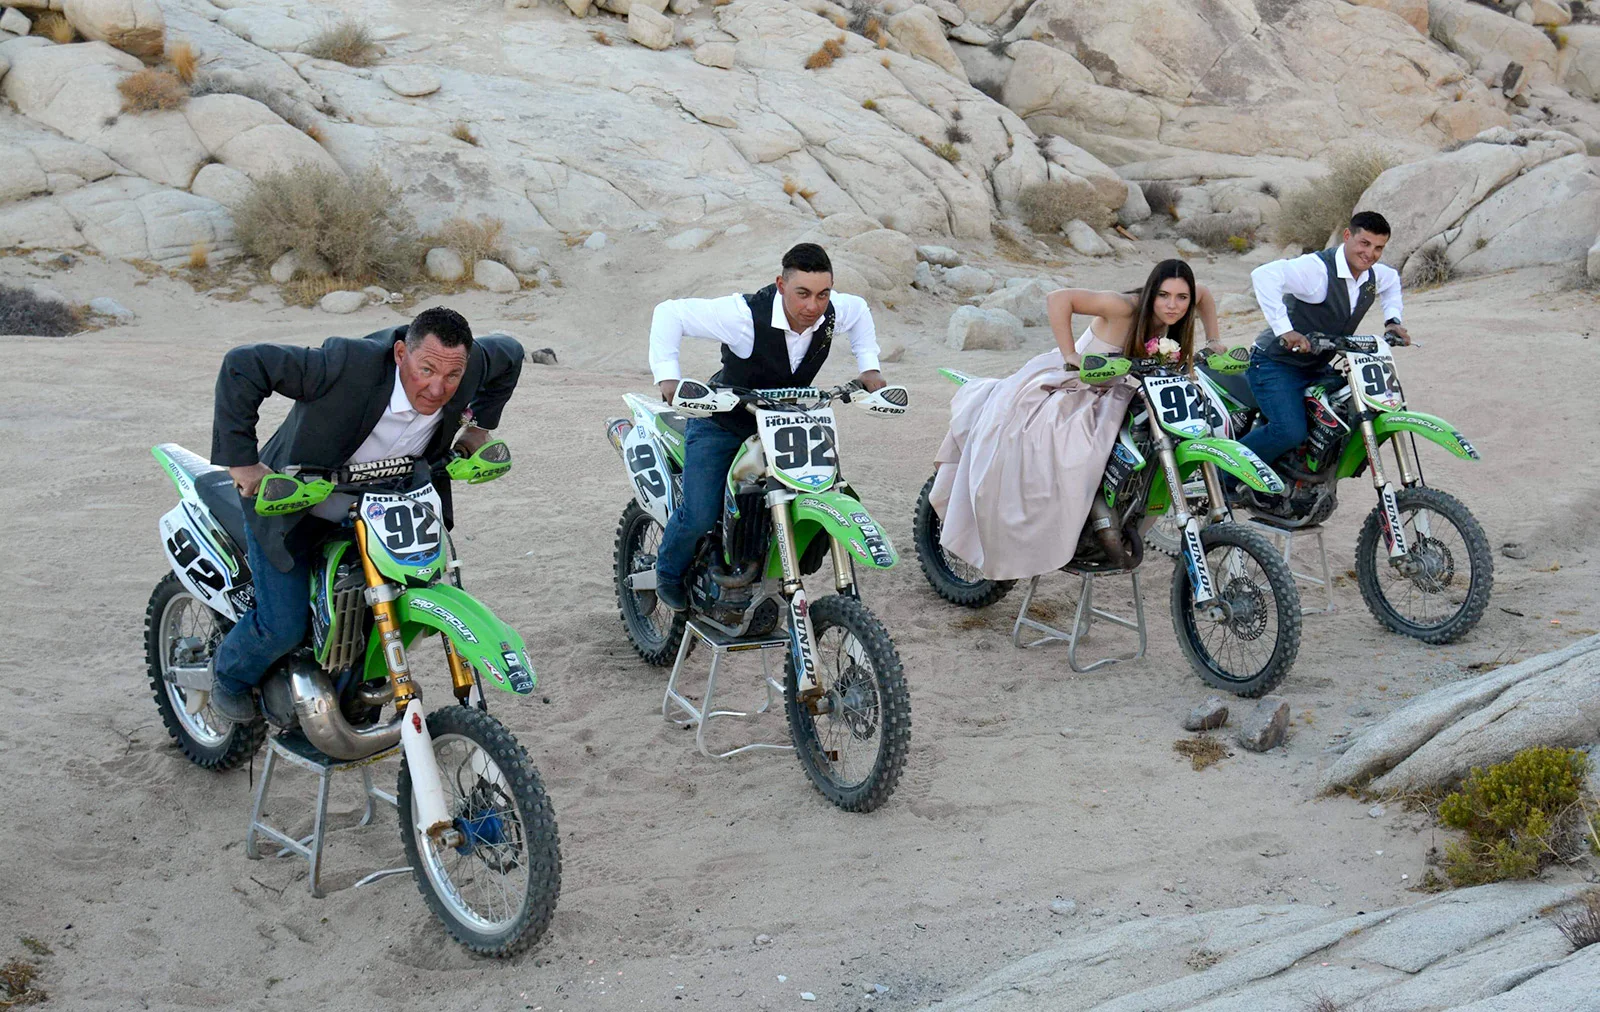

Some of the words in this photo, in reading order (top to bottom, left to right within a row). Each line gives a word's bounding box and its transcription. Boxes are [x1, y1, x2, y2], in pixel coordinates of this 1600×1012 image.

[761, 390, 818, 399] RENTHAL
[1149, 377, 1187, 388] HOLCO
[1362, 363, 1401, 396] 92
[765, 415, 832, 428] HOLCOMB
[1159, 384, 1207, 424] 92
[350, 456, 414, 472] RENTHAL
[774, 425, 836, 470] 92
[168, 462, 190, 491] DUNLOP
[350, 465, 415, 482] RENTHAL
[626, 444, 667, 504] 92
[365, 487, 433, 503] HOLCOMB
[384, 501, 439, 550] 92
[1384, 492, 1406, 554] DUNLOP
[166, 527, 226, 600] 92
[1187, 530, 1213, 598] DUNLOP
[410, 598, 435, 609] PRO
[432, 606, 479, 644] CIRCUIT
[793, 603, 818, 686] DUNLOP
